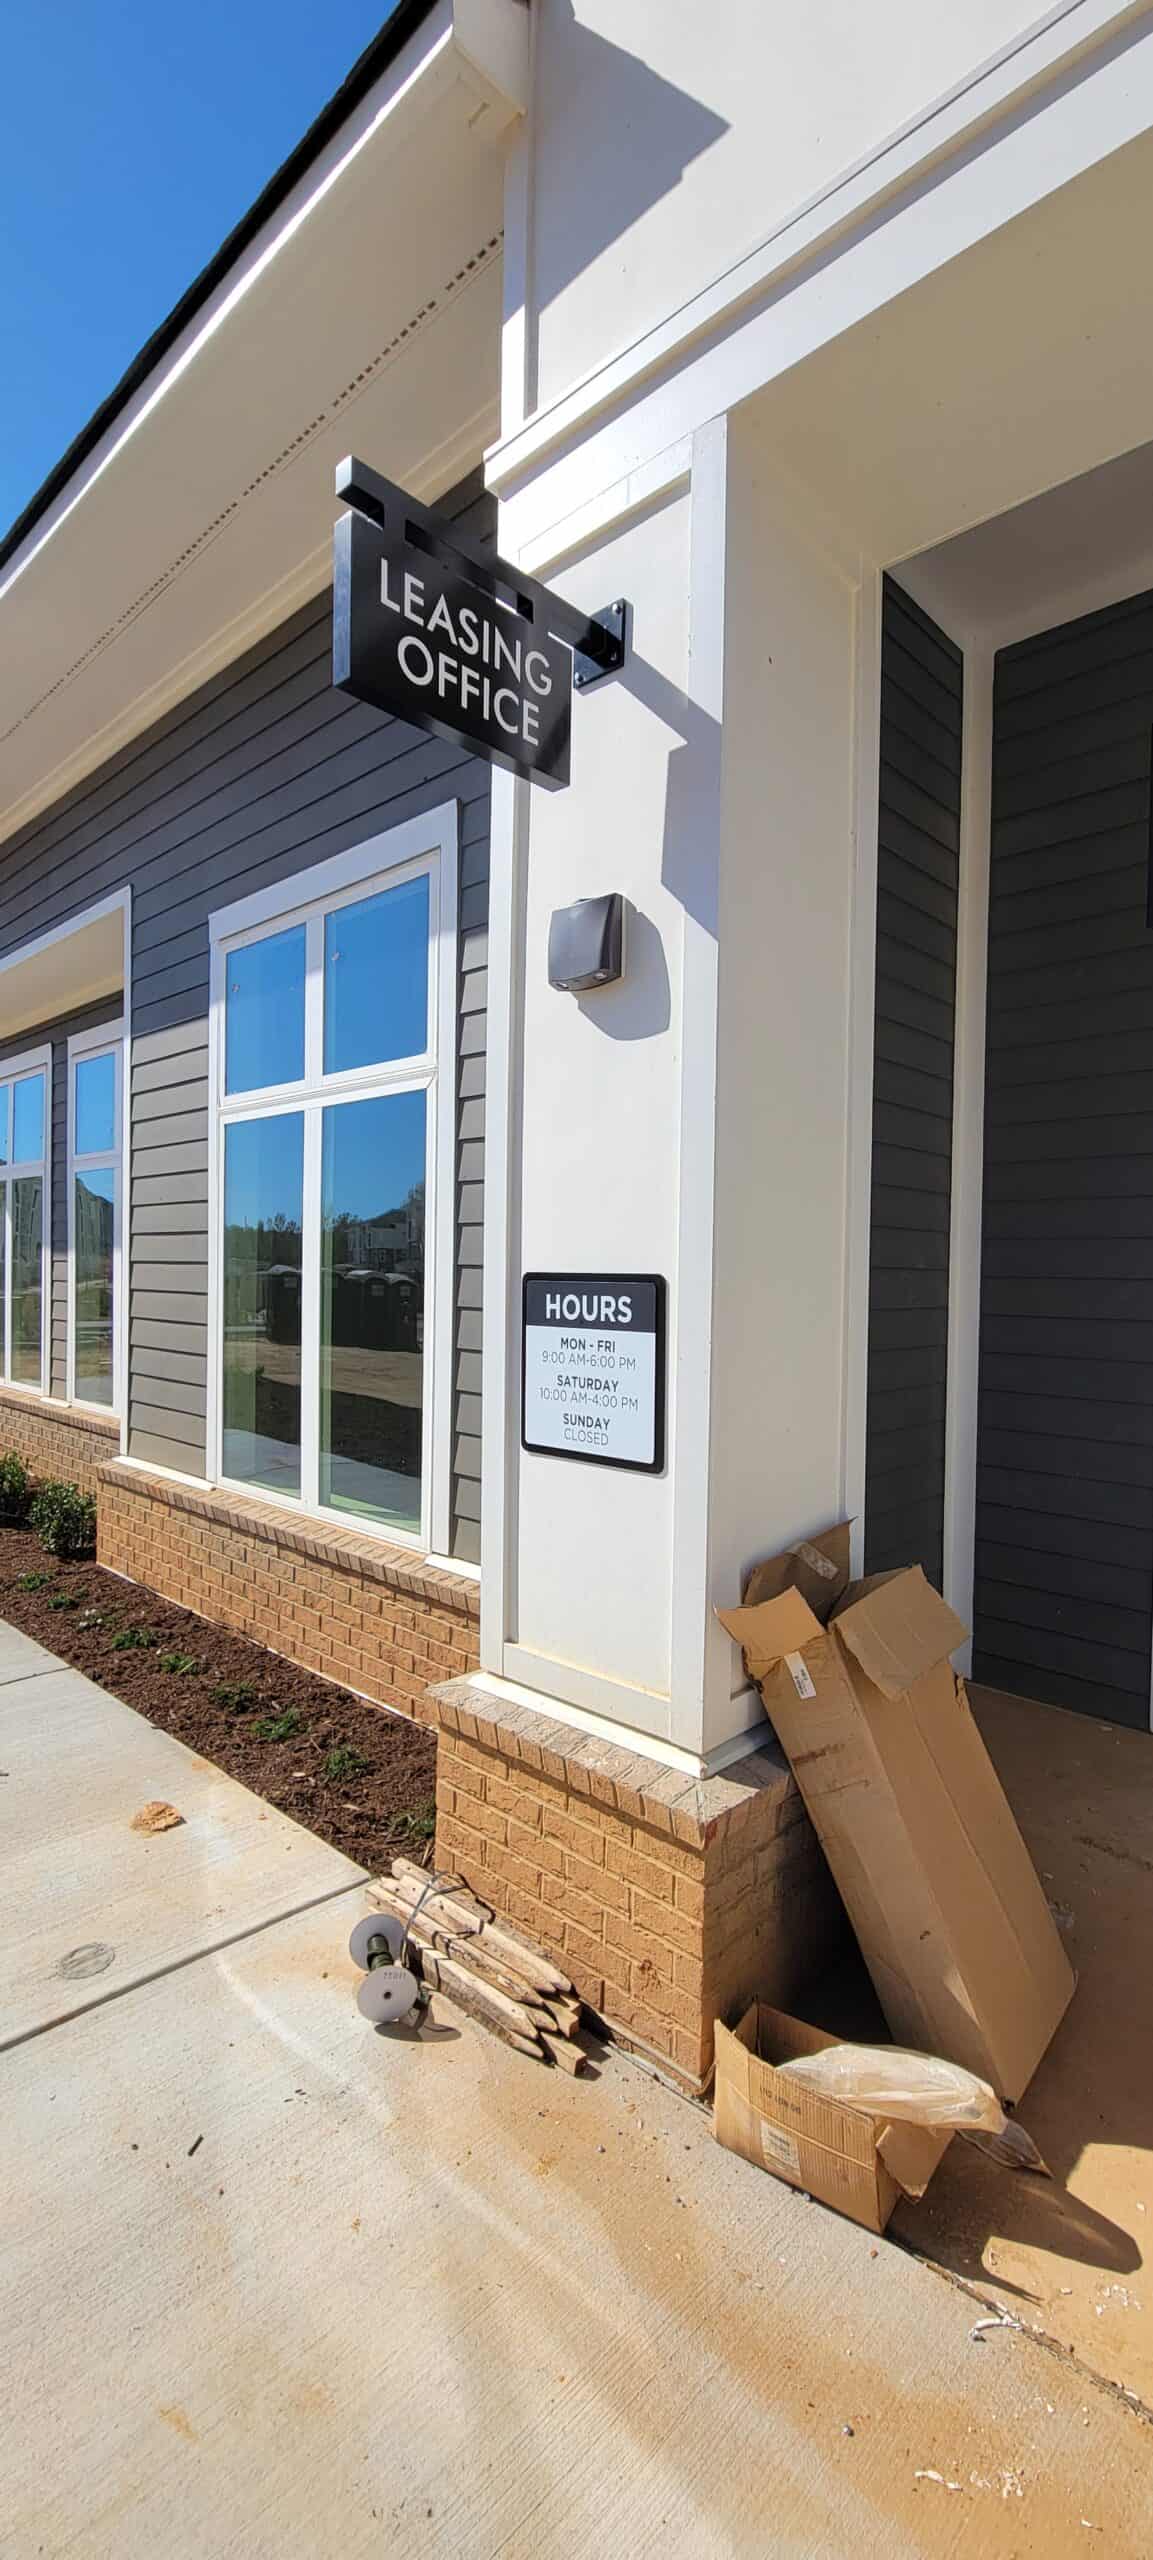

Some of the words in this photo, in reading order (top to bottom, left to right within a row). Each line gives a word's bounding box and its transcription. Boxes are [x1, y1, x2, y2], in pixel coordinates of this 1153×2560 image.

[380, 557, 552, 696] LEASING
[398, 635, 539, 746] OFFICE
[545, 1293, 633, 1323] HOURS
[560, 1337, 586, 1350] MON
[597, 1340, 616, 1353] FRI
[542, 1350, 566, 1364] 9:00
[568, 1353, 616, 1368] AM-6:00
[619, 1357, 636, 1370] PM
[557, 1375, 619, 1392] SATURDAY
[539, 1387, 567, 1402] 10:00
[621, 1396, 639, 1411] PM
[562, 1413, 611, 1430] SUNDAY
[564, 1428, 609, 1446] CLOSED
